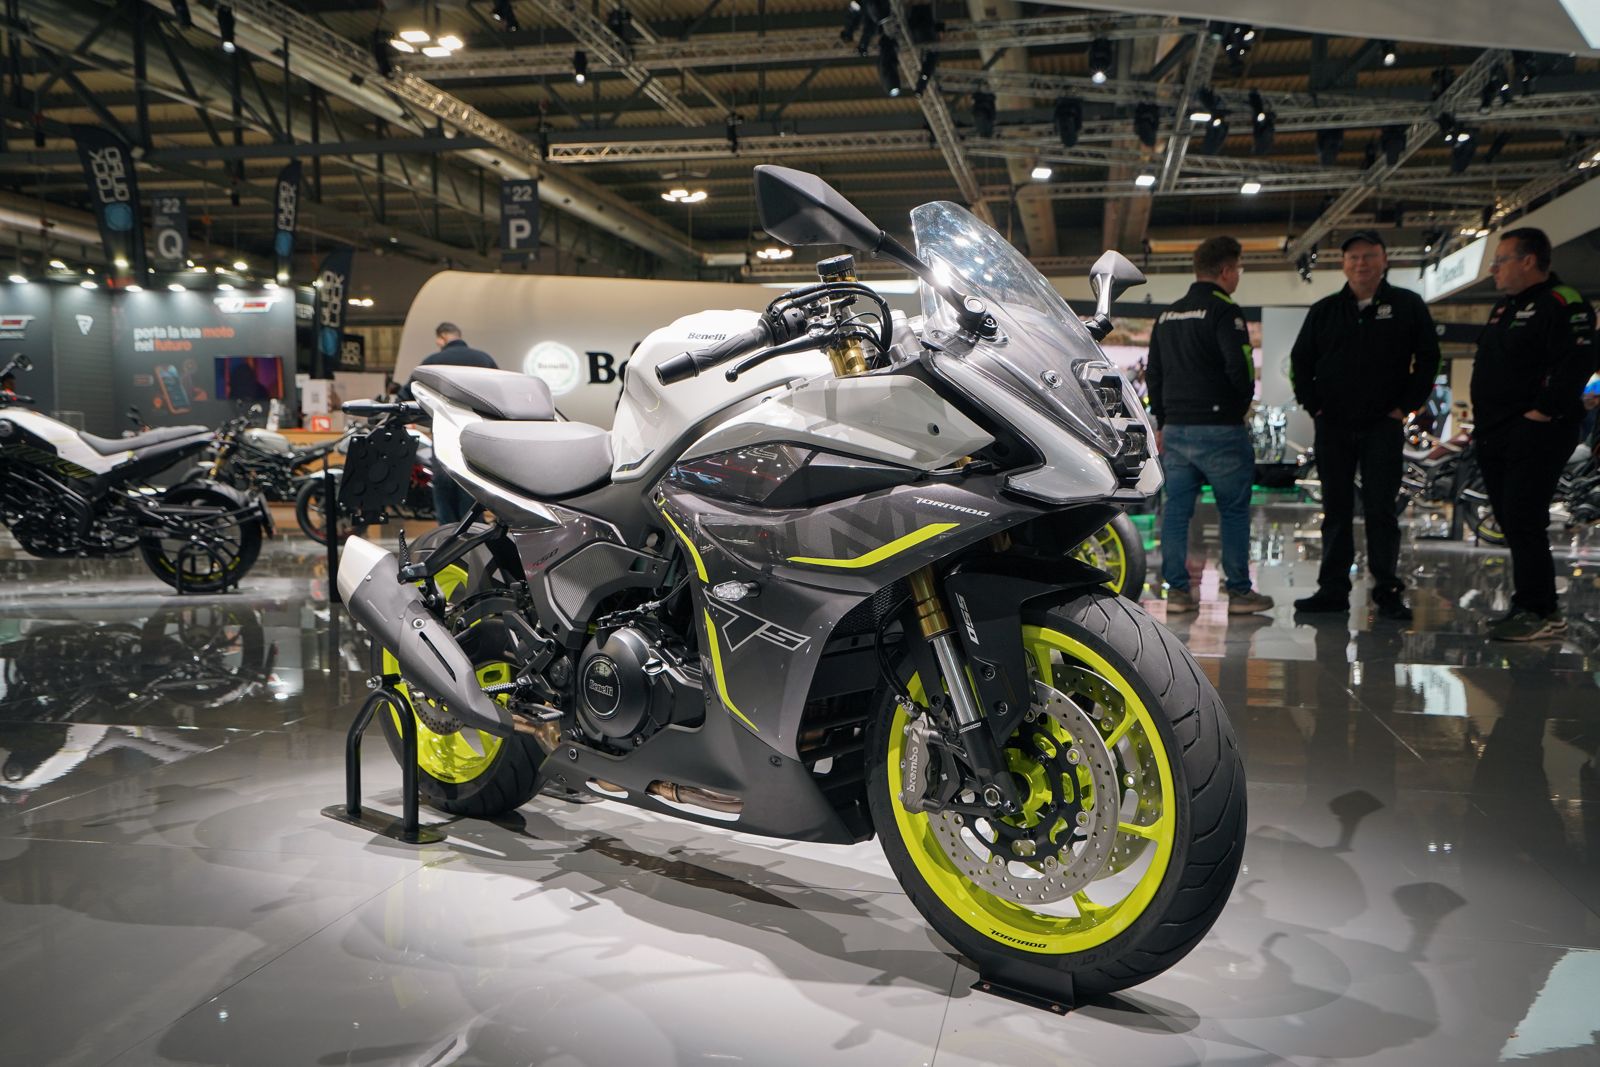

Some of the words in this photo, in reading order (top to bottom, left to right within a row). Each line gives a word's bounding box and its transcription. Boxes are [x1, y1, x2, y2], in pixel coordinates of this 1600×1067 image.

[511, 185, 533, 202] 22
[162, 198, 180, 213] 22
[158, 229, 183, 259] Q
[509, 218, 532, 249] P
[688, 332, 727, 341] Benelli
[913, 496, 990, 518] TORNADO
[955, 592, 980, 646] 550
[589, 679, 614, 697] Benelli
[907, 746, 919, 793] brembo
[989, 928, 1048, 949] TORNADO
